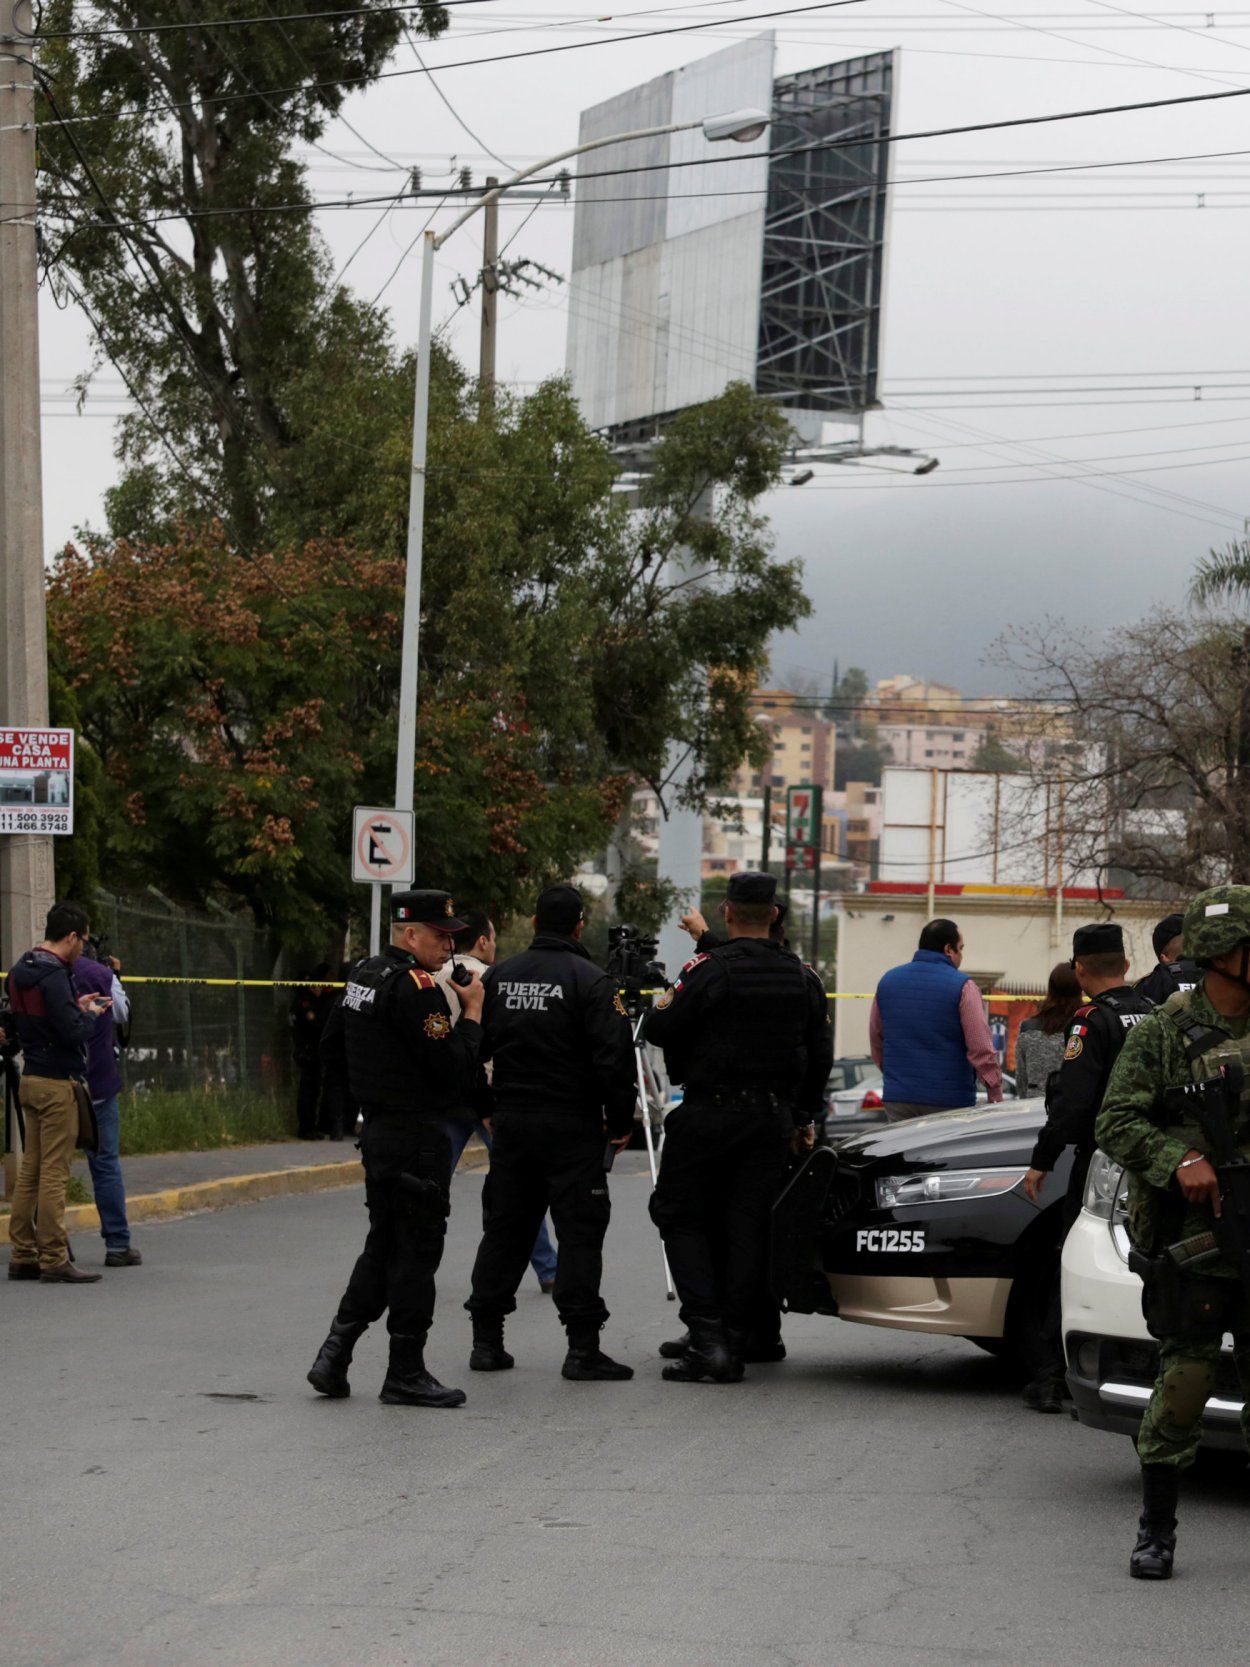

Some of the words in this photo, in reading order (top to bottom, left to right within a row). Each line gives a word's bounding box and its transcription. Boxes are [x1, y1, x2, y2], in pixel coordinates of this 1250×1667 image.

[19, 733, 69, 745] VENDE
[12, 744, 51, 756] CASA
[0, 756, 19, 767] NA
[22, 756, 68, 768] PLANTA
[497, 981, 563, 999] FUERZA
[505, 995, 548, 1011] CIVIL
[856, 1230, 925, 1252] FC1255
